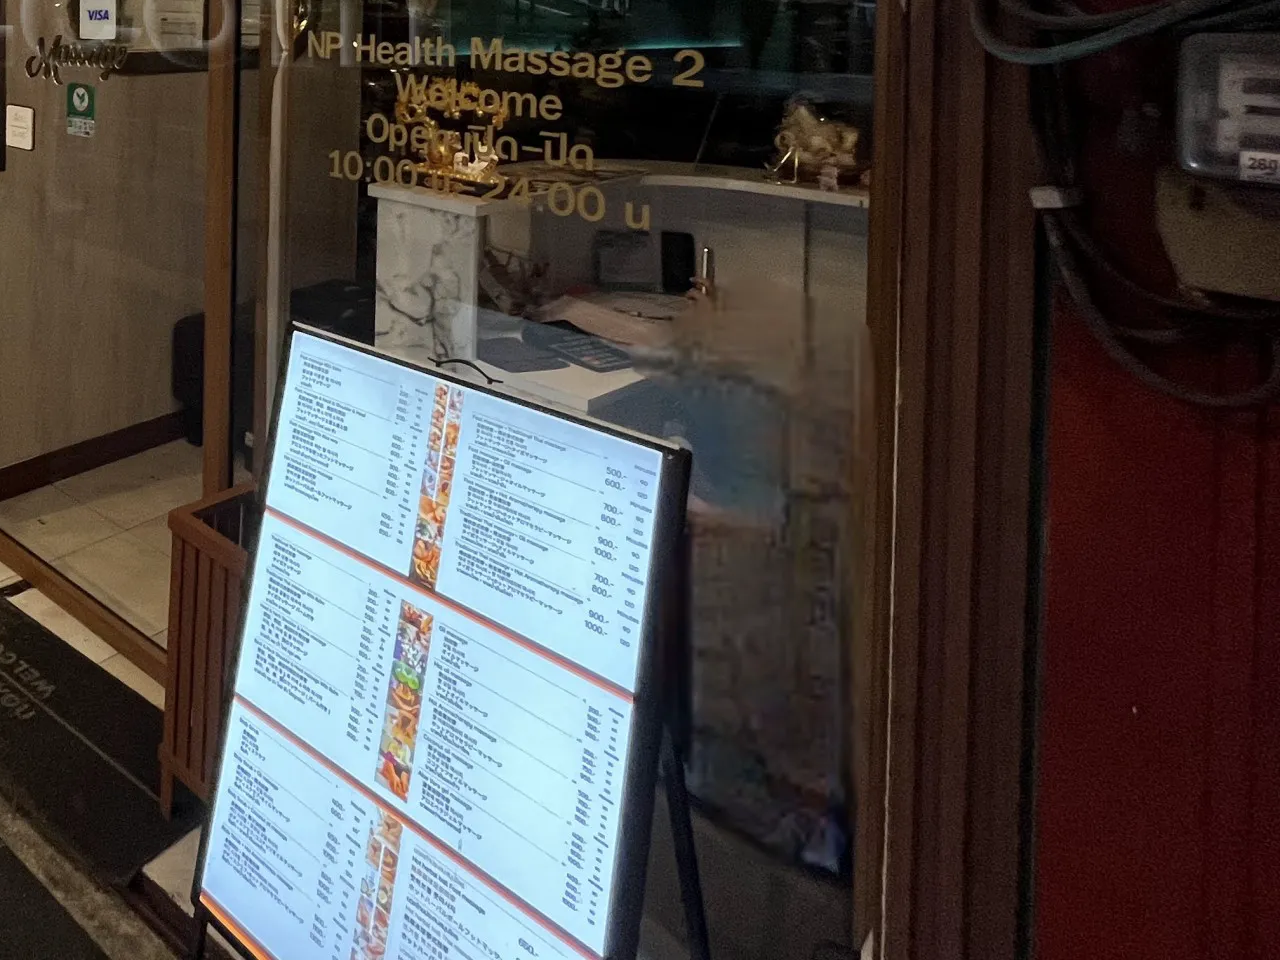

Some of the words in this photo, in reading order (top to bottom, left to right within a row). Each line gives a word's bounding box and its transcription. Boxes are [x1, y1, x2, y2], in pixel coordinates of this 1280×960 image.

[87, 9, 109, 21] VISA
[307, 30, 343, 60] NP
[355, 32, 456, 68] Health
[469, 36, 652, 88] Massage
[671, 48, 705, 88] 2
[394, 73, 563, 121] Welcome
[328, 149, 419, 190] 10:00
